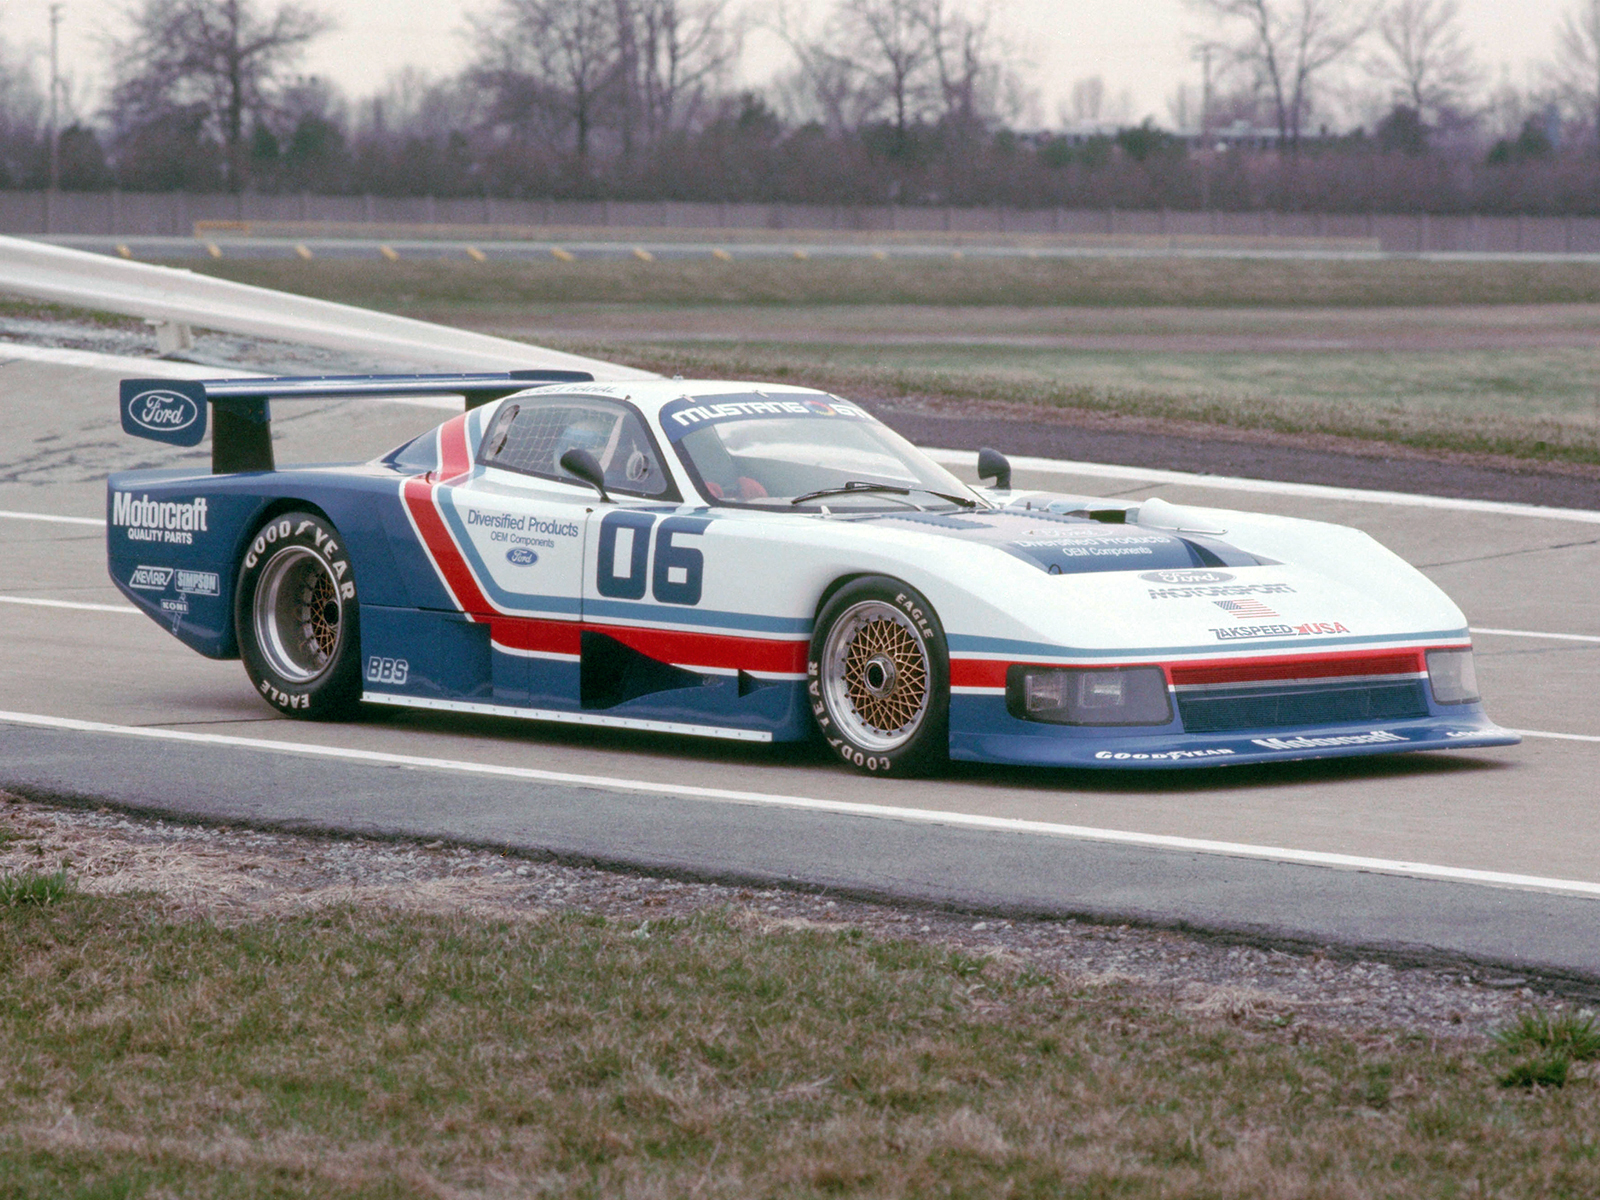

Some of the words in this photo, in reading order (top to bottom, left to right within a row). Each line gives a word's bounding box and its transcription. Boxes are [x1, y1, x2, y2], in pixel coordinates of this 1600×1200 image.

[141, 394, 184, 425] Ford
[671, 400, 810, 427] MUSTANG
[113, 491, 208, 532] Motorcraft
[467, 509, 526, 531] Diversified
[528, 517, 579, 538] Products
[128, 527, 164, 542] QUALITY
[164, 531, 193, 545] PARTS
[490, 530, 508, 543] OEM
[509, 533, 555, 549] Components
[245, 519, 356, 600] GOODYEAR
[511, 549, 534, 564] Ford
[596, 510, 714, 606] 06
[1062, 547, 1090, 557] OEM
[1090, 545, 1153, 557] Components
[135, 567, 168, 586] KEVLAR
[177, 571, 216, 590] SIMPSON
[1162, 570, 1220, 584] Ford
[1148, 582, 1298, 600] MOTORSPORT
[162, 601, 187, 611] KONI
[894, 592, 935, 640] EAGLE
[1209, 623, 1295, 641] ZAKSPEED
[1304, 621, 1350, 636] USA
[367, 656, 409, 684] BBS
[260, 679, 310, 709] EAGLE
[808, 660, 891, 771] GOODYEAR
[1251, 730, 1411, 750] Motorcraft
[1095, 748, 1235, 761] GOODYEAR
